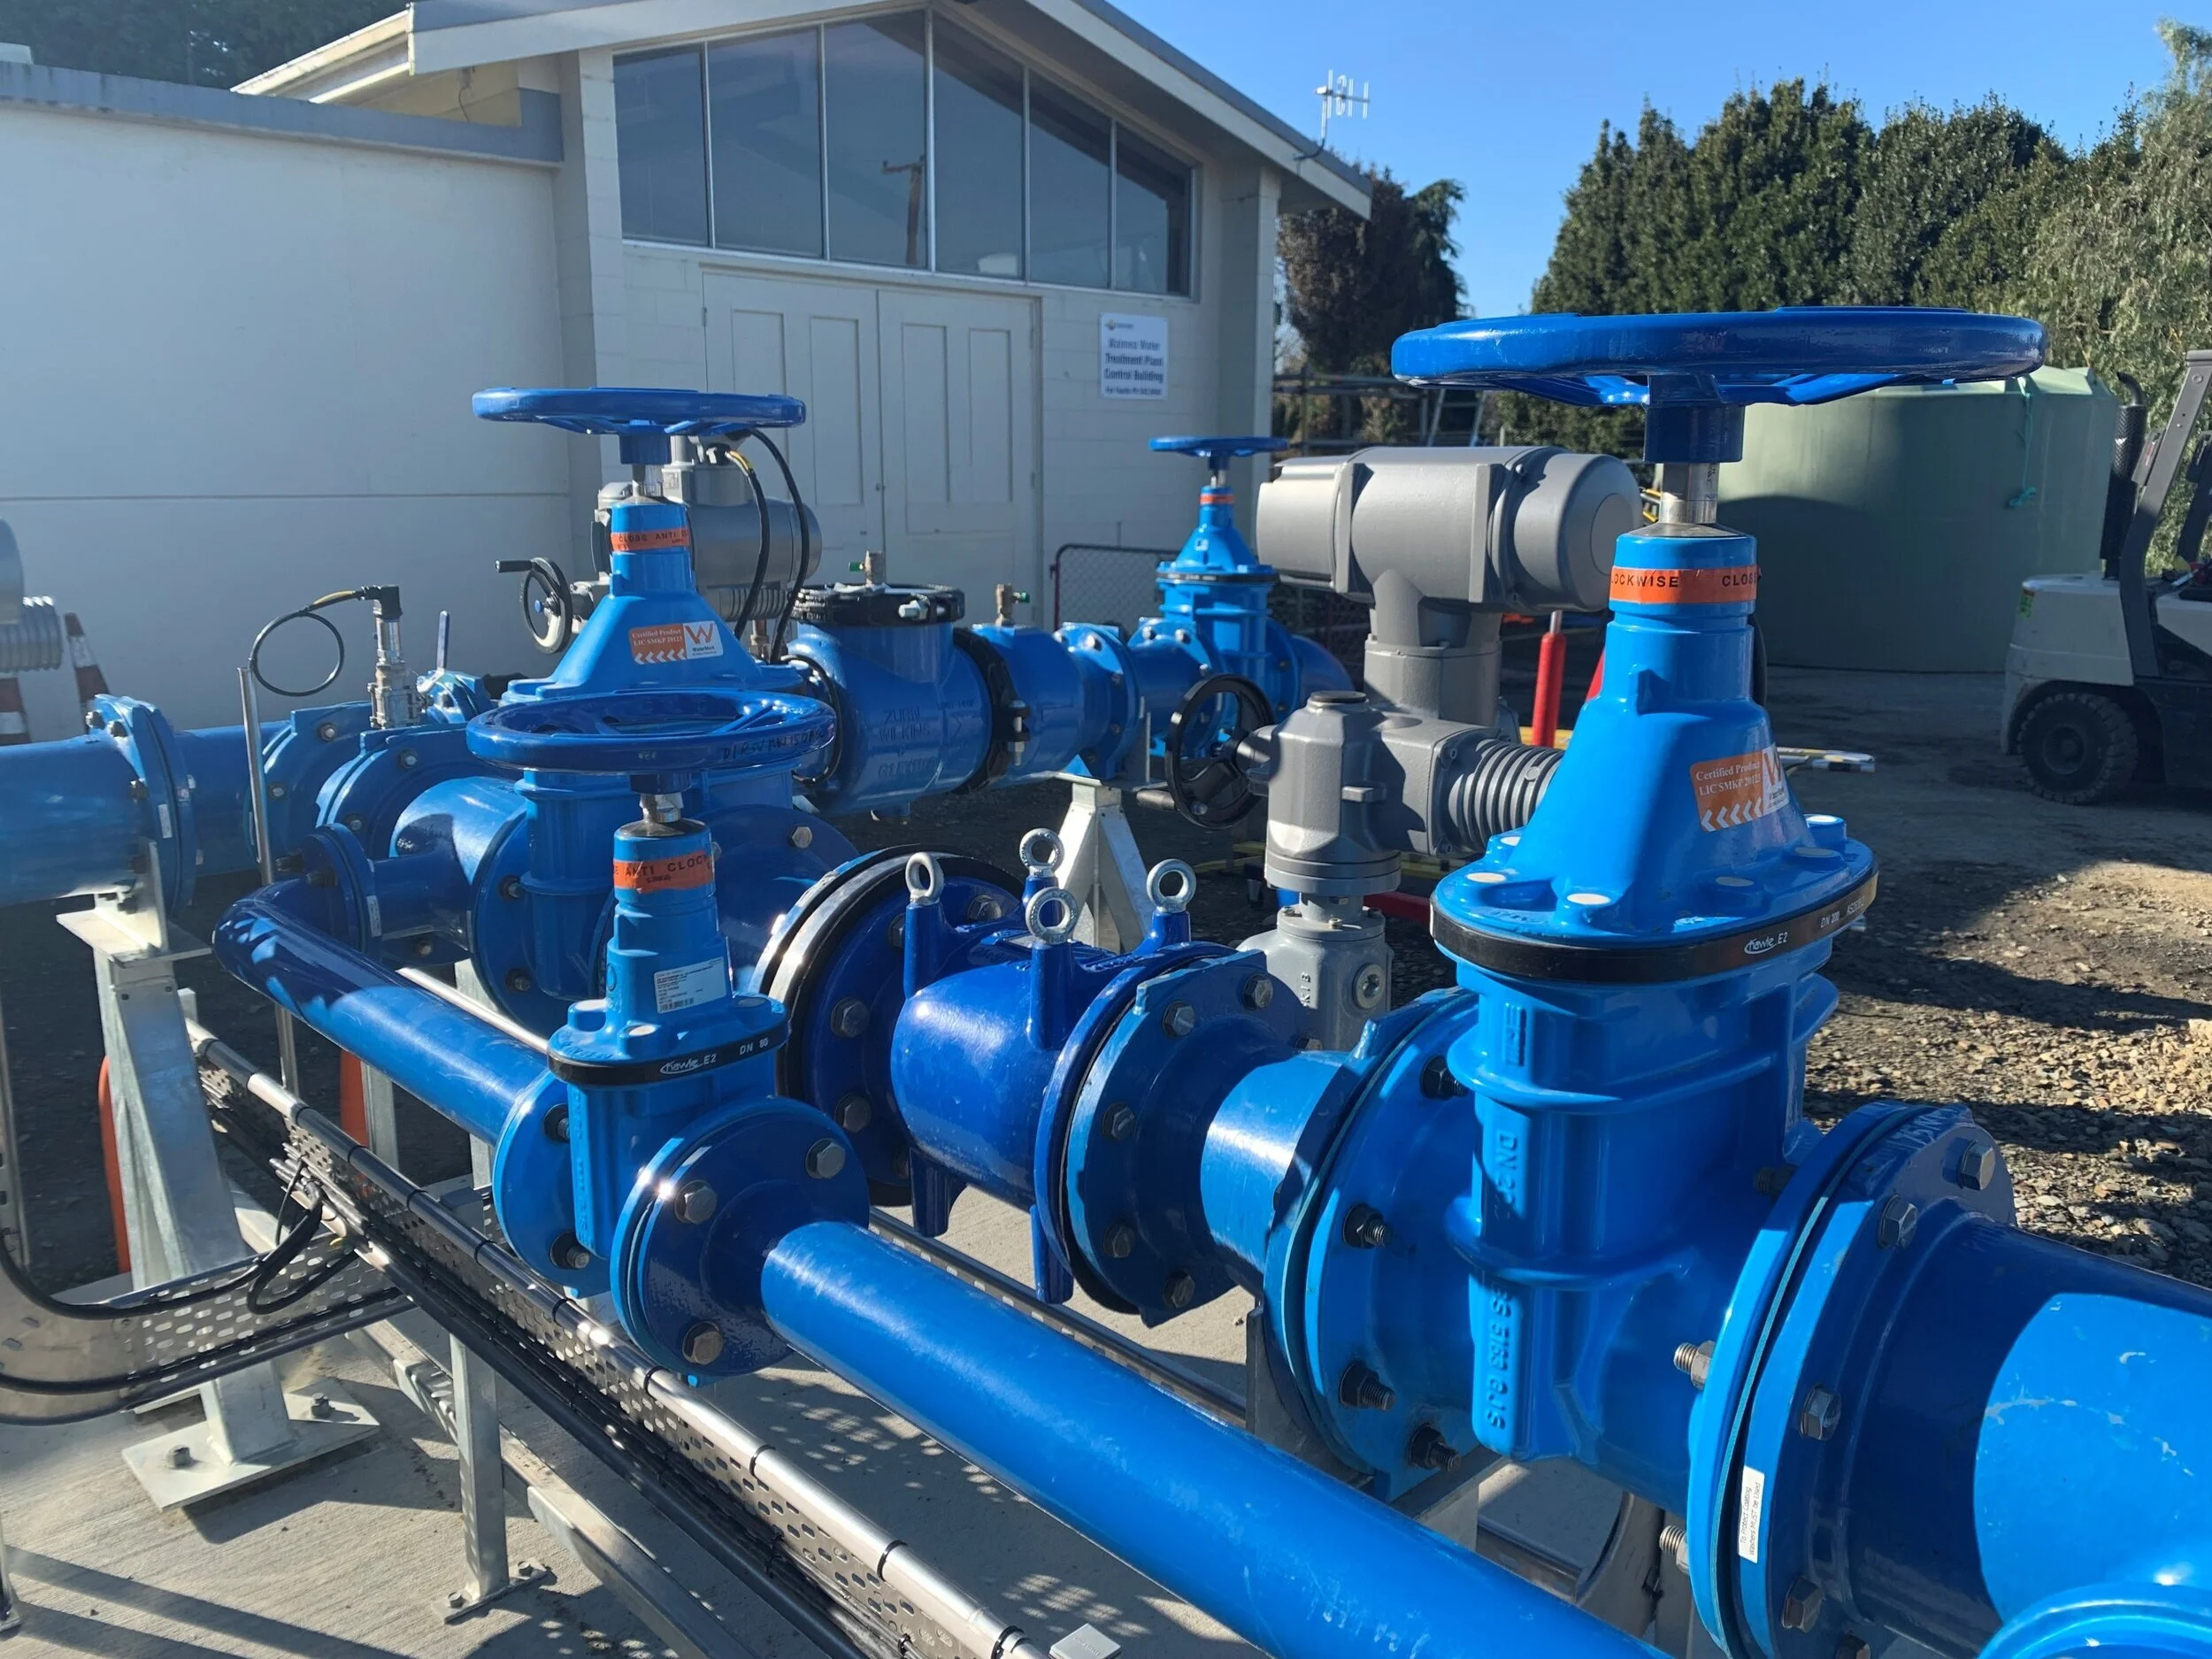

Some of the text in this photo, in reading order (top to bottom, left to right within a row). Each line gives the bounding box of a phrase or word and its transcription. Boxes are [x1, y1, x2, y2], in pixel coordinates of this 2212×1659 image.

[1105, 353, 1164, 366] Treatment Plant
[1104, 369, 1164, 384] Control Building
[1611, 573, 1678, 588] OCKWISE
[632, 629, 657, 638] Certified
[1696, 766, 1733, 781] Certified
[1699, 783, 1717, 795] LIC
[1778, 932, 1788, 945] E2
[703, 1053, 718, 1065] E2
[740, 1042, 754, 1055] DN
[1743, 1487, 1752, 1511] Coating
[1752, 1500, 1759, 1509] be
